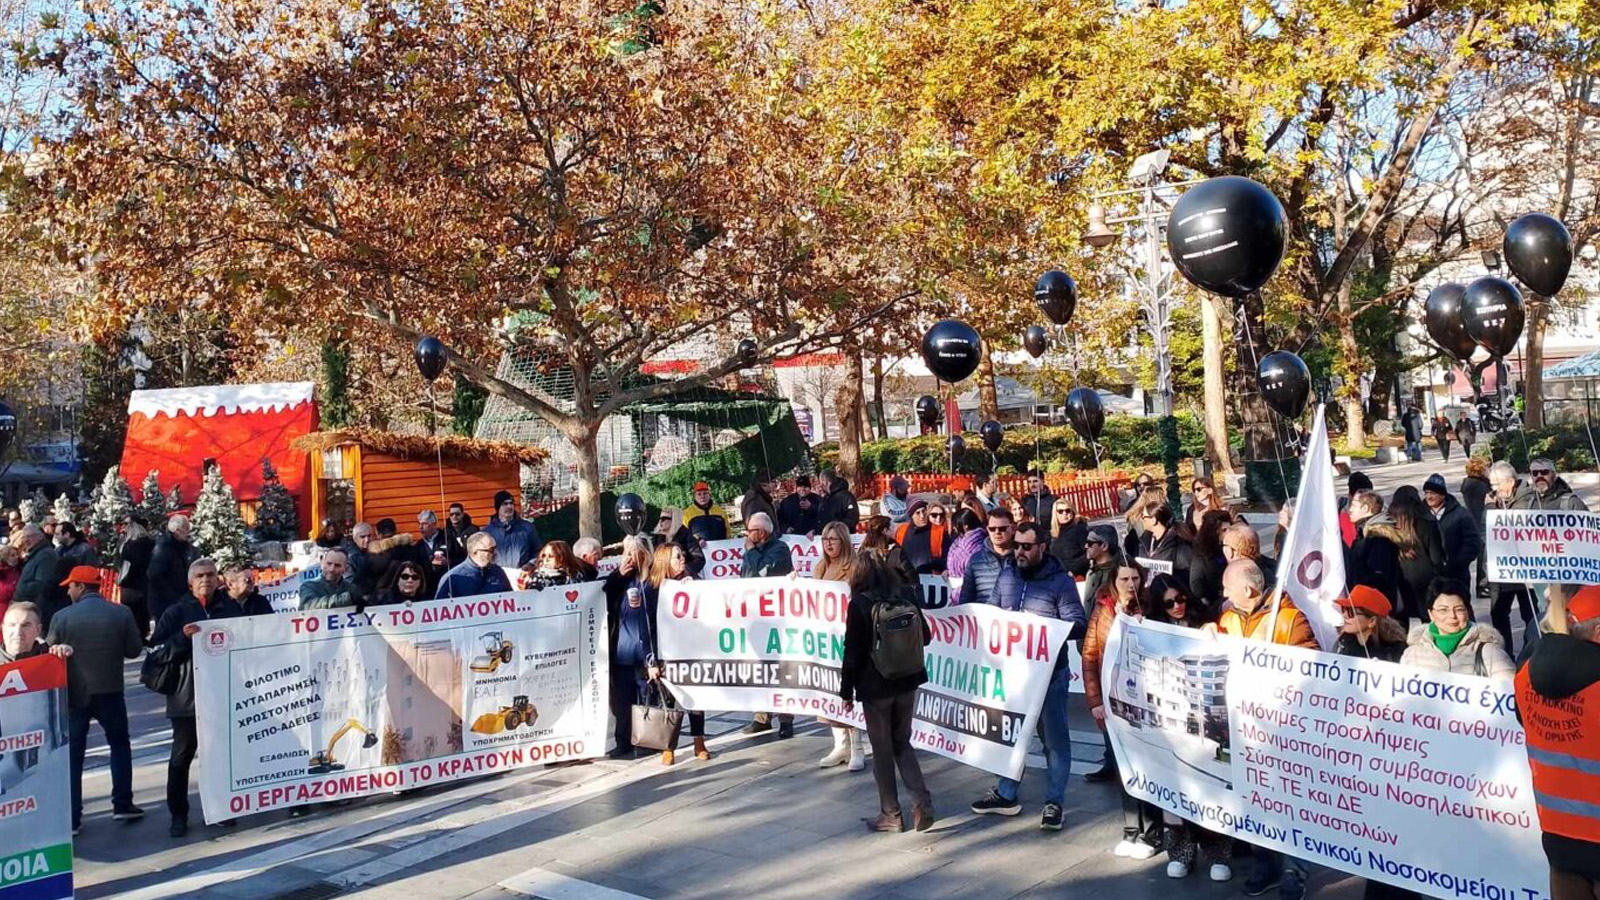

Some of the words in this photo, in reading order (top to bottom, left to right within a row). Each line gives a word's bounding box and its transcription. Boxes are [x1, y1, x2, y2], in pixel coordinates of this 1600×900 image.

[1492, 529, 1510, 541] ΤΟ
[1514, 529, 1558, 541] ΚΥΜΑ
[1564, 529, 1600, 545] ΦΥΓΗ
[1541, 543, 1565, 554] ΜΕ
[1496, 556, 1600, 570] ΜΟΝΙΜΟΠΟΙΗΣ
[1498, 568, 1600, 583] ΣΥΜΒΑΣΙΟΥΧΩ
[291, 616, 320, 634] ΤΟ
[327, 612, 382, 631] Ε.Σ.Υ.
[389, 609, 415, 627] ΤΟ
[421, 598, 531, 623] ΔΙΑΛΥΟΥΝ...
[718, 627, 747, 654] ΟΙ
[989, 618, 1049, 662] ΟΡΙΑ
[244, 664, 301, 689] ΦΙΛΟΤΙΜΟ
[474, 675, 518, 686] ΜΝΗΜΟΝΙΑ
[666, 662, 780, 685] ΠΡΟΣΛΗΨΕΙΣ
[1242, 646, 1294, 672] Κάτω
[1300, 660, 1341, 681] από
[1348, 668, 1382, 692] την
[1391, 674, 1470, 704] μάσκα
[235, 676, 319, 711] ΑΥΤΑΠΑΡΝΗΣΗ
[238, 693, 322, 728] ΧΡΩΣΤΟΥΜΕΝΑ
[247, 711, 321, 743] ΡΕΠΟ-ΑΔΕΙΕΣ
[916, 692, 988, 735] ΑΝΘΥΓΙΕΙΝΟ
[1309, 694, 1338, 711] στα
[1344, 696, 1404, 723] βαρέα
[1412, 713, 1441, 730] και
[1314, 718, 1430, 758] προσλήψεις
[260, 749, 310, 763] ΕΞΑΘΛΙΩΣΗ
[230, 793, 251, 813] ΟΙ
[258, 770, 405, 808] ΕΡΓΑΖΟΜΕΝΟΙ
[410, 765, 433, 783] ΤΟ
[438, 748, 524, 777] ΚΡΑΤΟΥΝ
[530, 740, 585, 761] ΟΡΘΙΟ
[235, 768, 305, 787] ΥΠΟΣΤΕΛΕΧΩΣΗ
[1369, 757, 1518, 800] συμβασιούχων
[1279, 775, 1303, 798] ΤΕ
[1308, 788, 1332, 807] και
[1336, 792, 1364, 815] ΔΕ
[1319, 770, 1380, 797] ενιαίου
[1386, 782, 1531, 829] Νοσηλευτικού
[1300, 808, 1398, 847] αναστολών
[1179, 792, 1287, 843] Εργαζομένων
[1292, 829, 1362, 866] Γενικού
[1369, 850, 1515, 900] Νοσοκομείου
